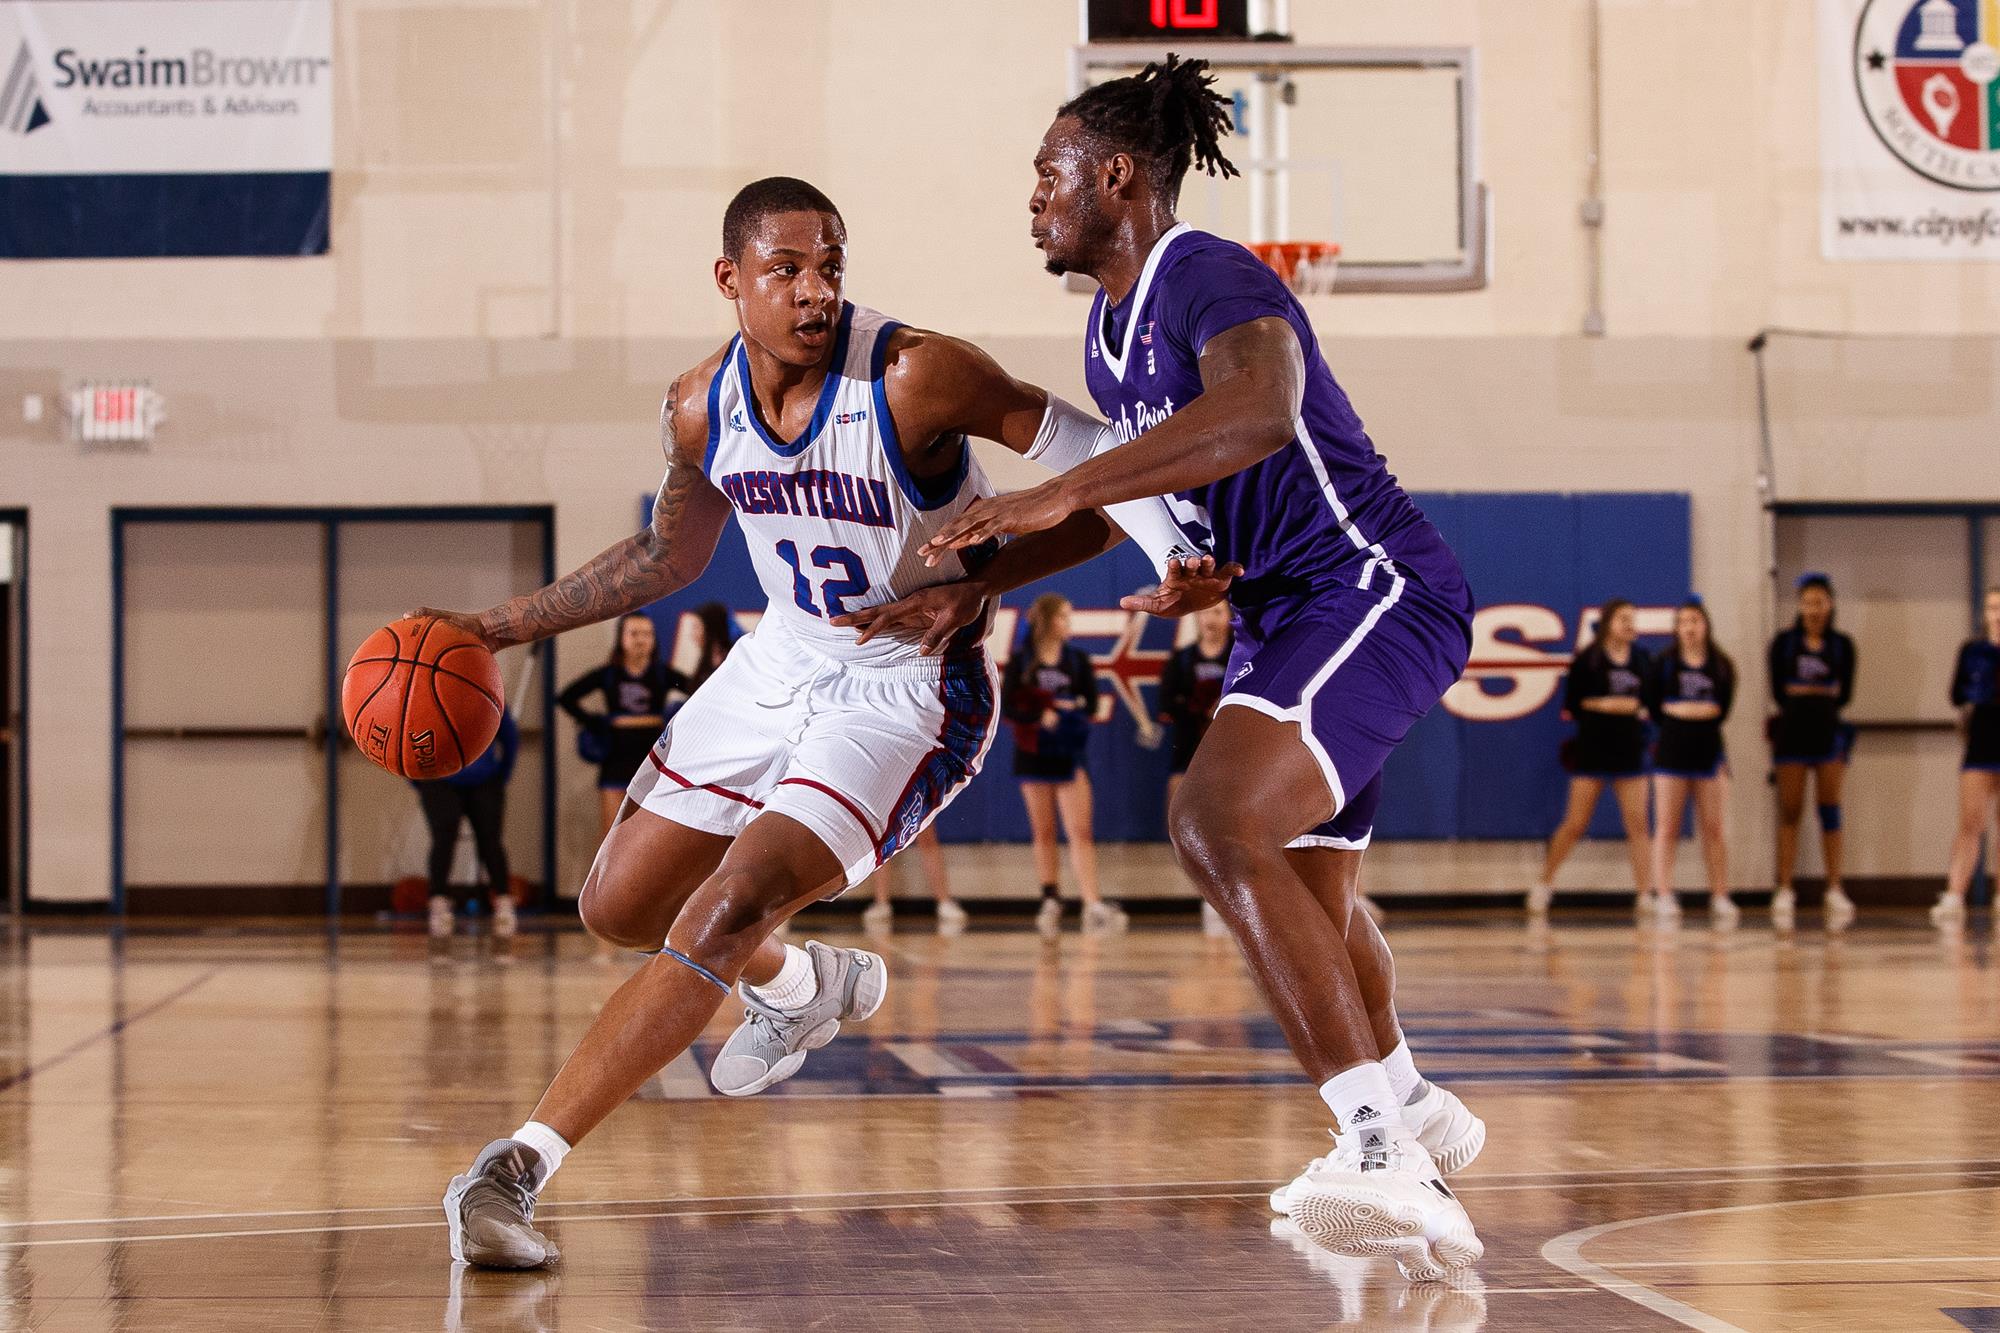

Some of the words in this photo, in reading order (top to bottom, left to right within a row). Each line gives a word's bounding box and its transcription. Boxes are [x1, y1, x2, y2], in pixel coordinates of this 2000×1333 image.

[835, 410, 867, 425] SOUTH
[775, 538, 871, 619] 12
[1350, 1110, 1381, 1125] adidas
